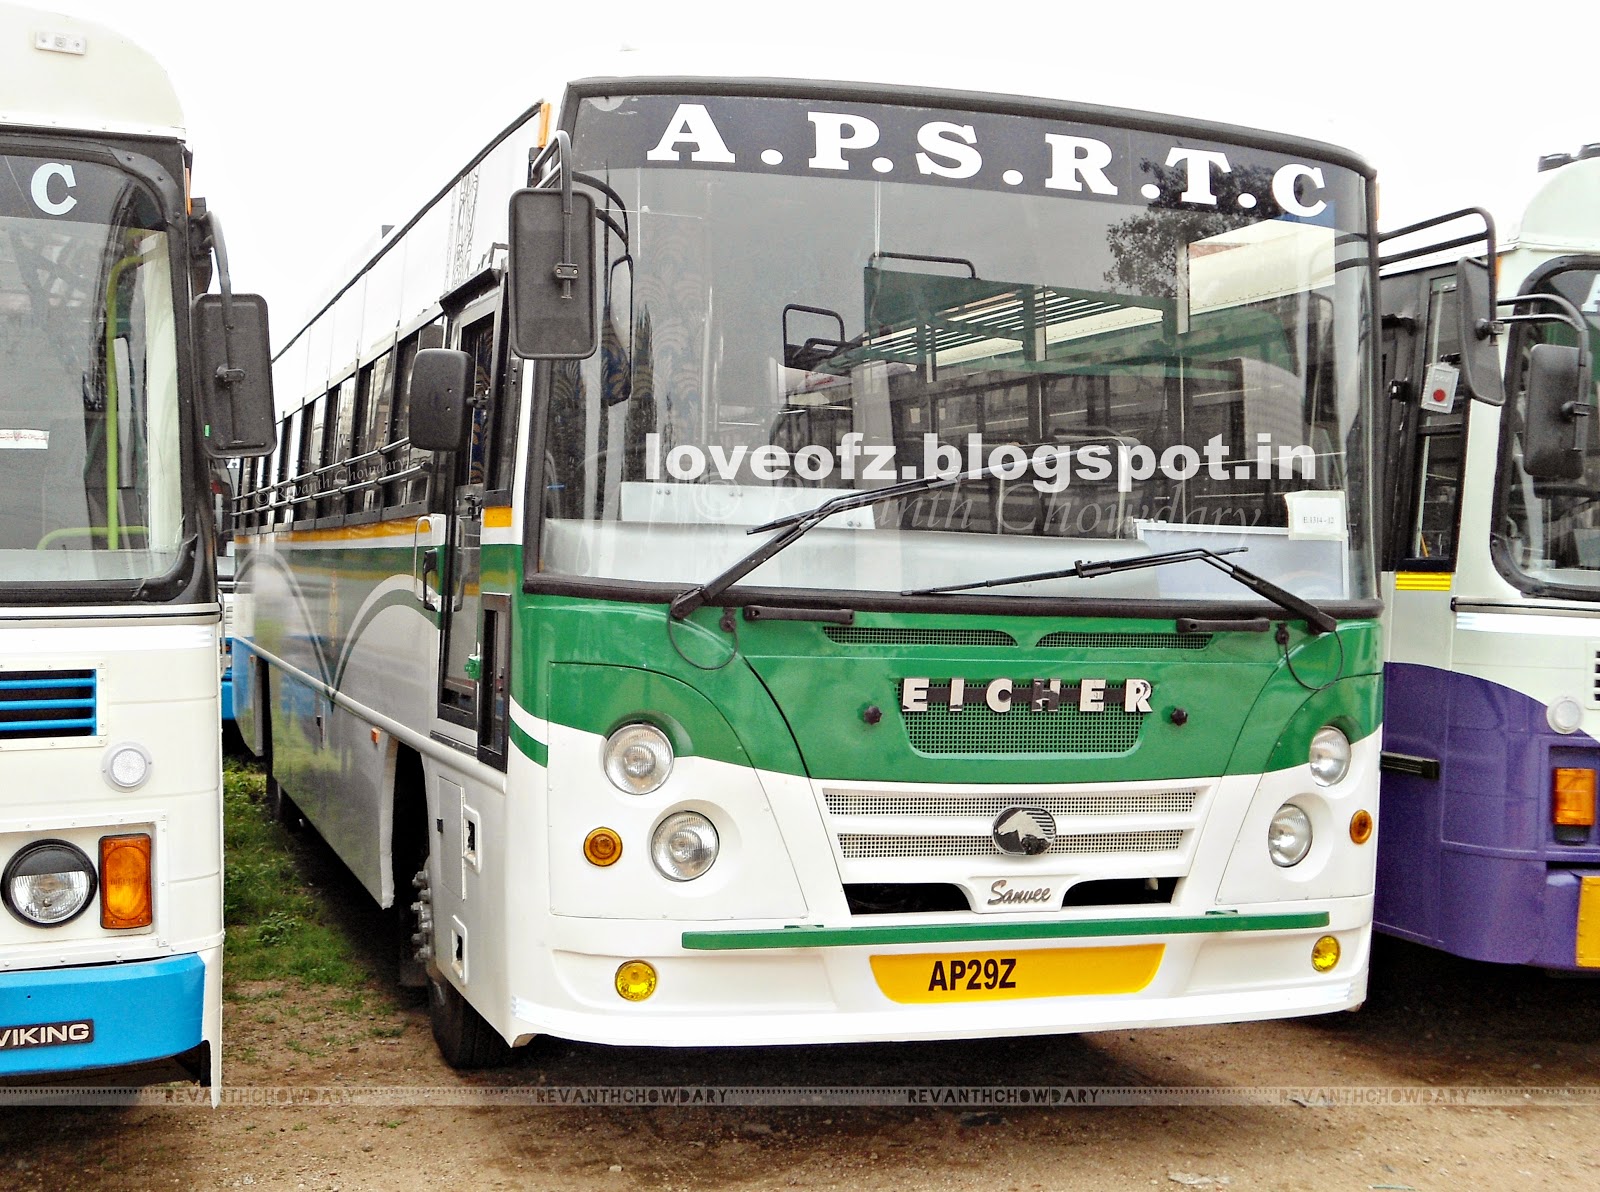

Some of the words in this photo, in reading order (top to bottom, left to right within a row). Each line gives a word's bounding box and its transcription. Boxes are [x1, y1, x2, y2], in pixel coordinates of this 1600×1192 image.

[31, 162, 77, 216] C
[901, 677, 1153, 713] EICHER
[987, 879, 1051, 906] Sanvee
[928, 958, 1017, 991] AP29Z
